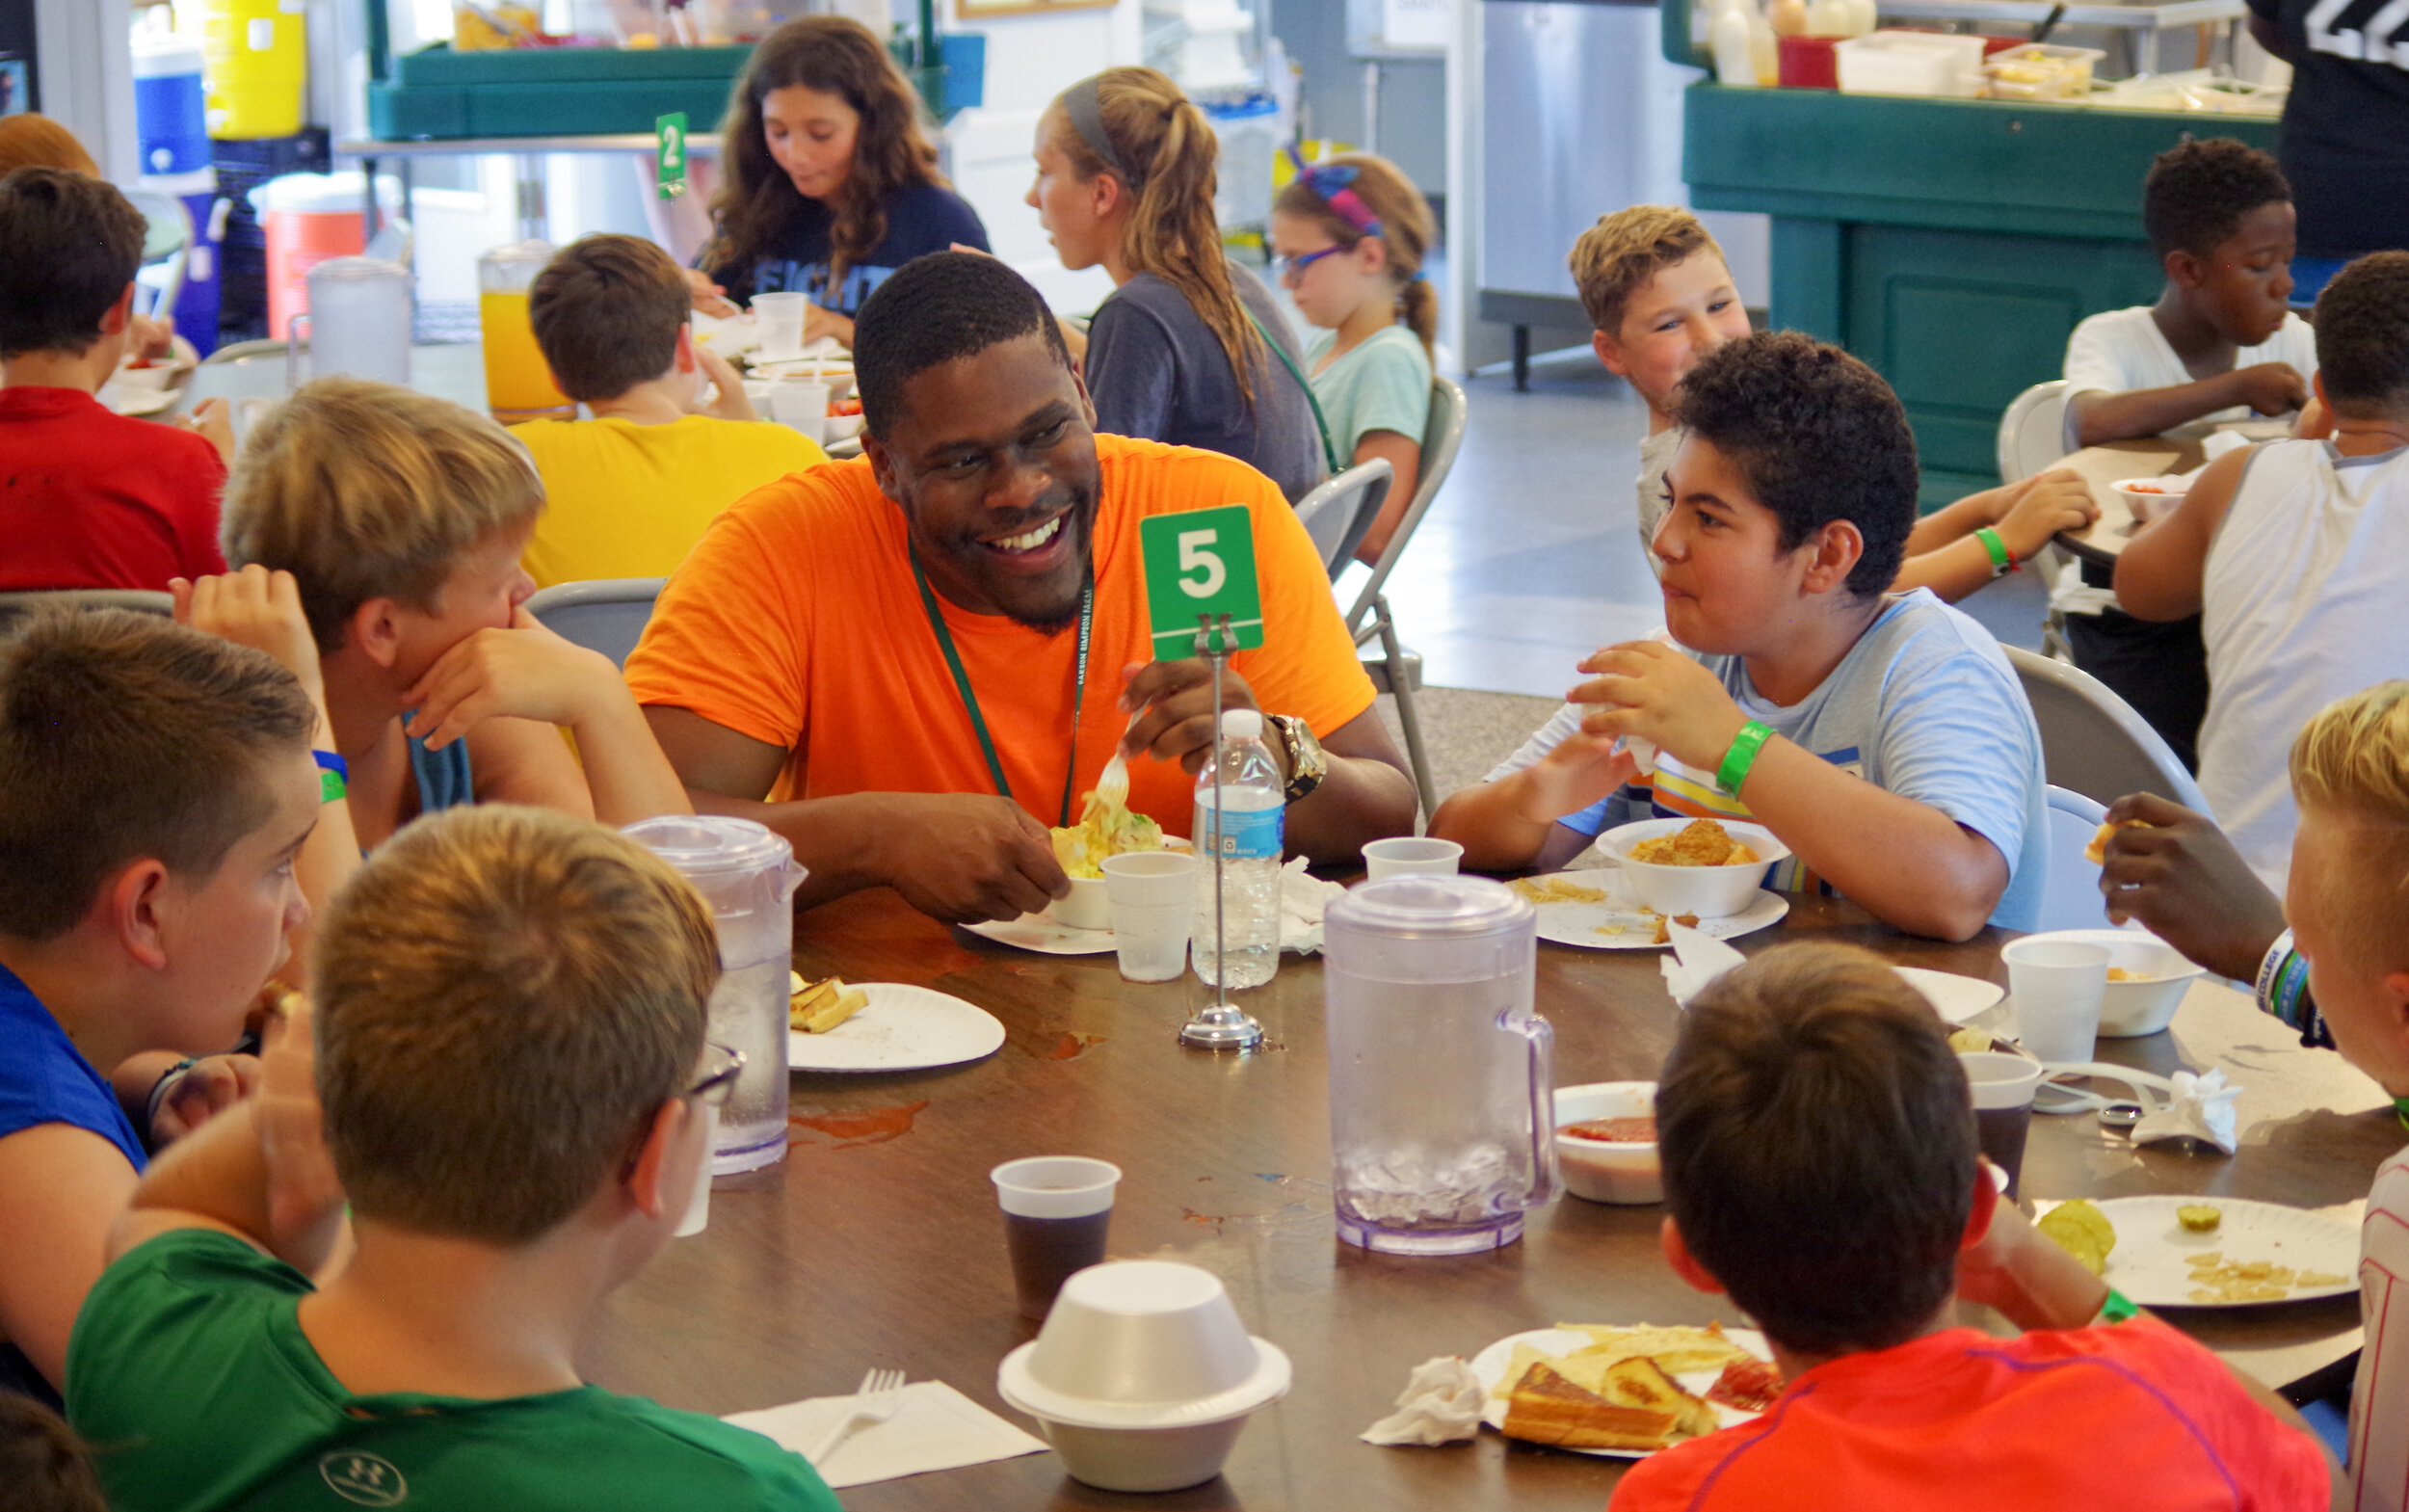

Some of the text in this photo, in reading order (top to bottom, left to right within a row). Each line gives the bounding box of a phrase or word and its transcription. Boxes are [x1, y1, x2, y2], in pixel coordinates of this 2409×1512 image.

[663, 124, 680, 166] 2
[1178, 528, 1227, 598] 5
[1079, 615, 1091, 651] SIMPSON
[2258, 949, 2281, 996] COLLEGE
